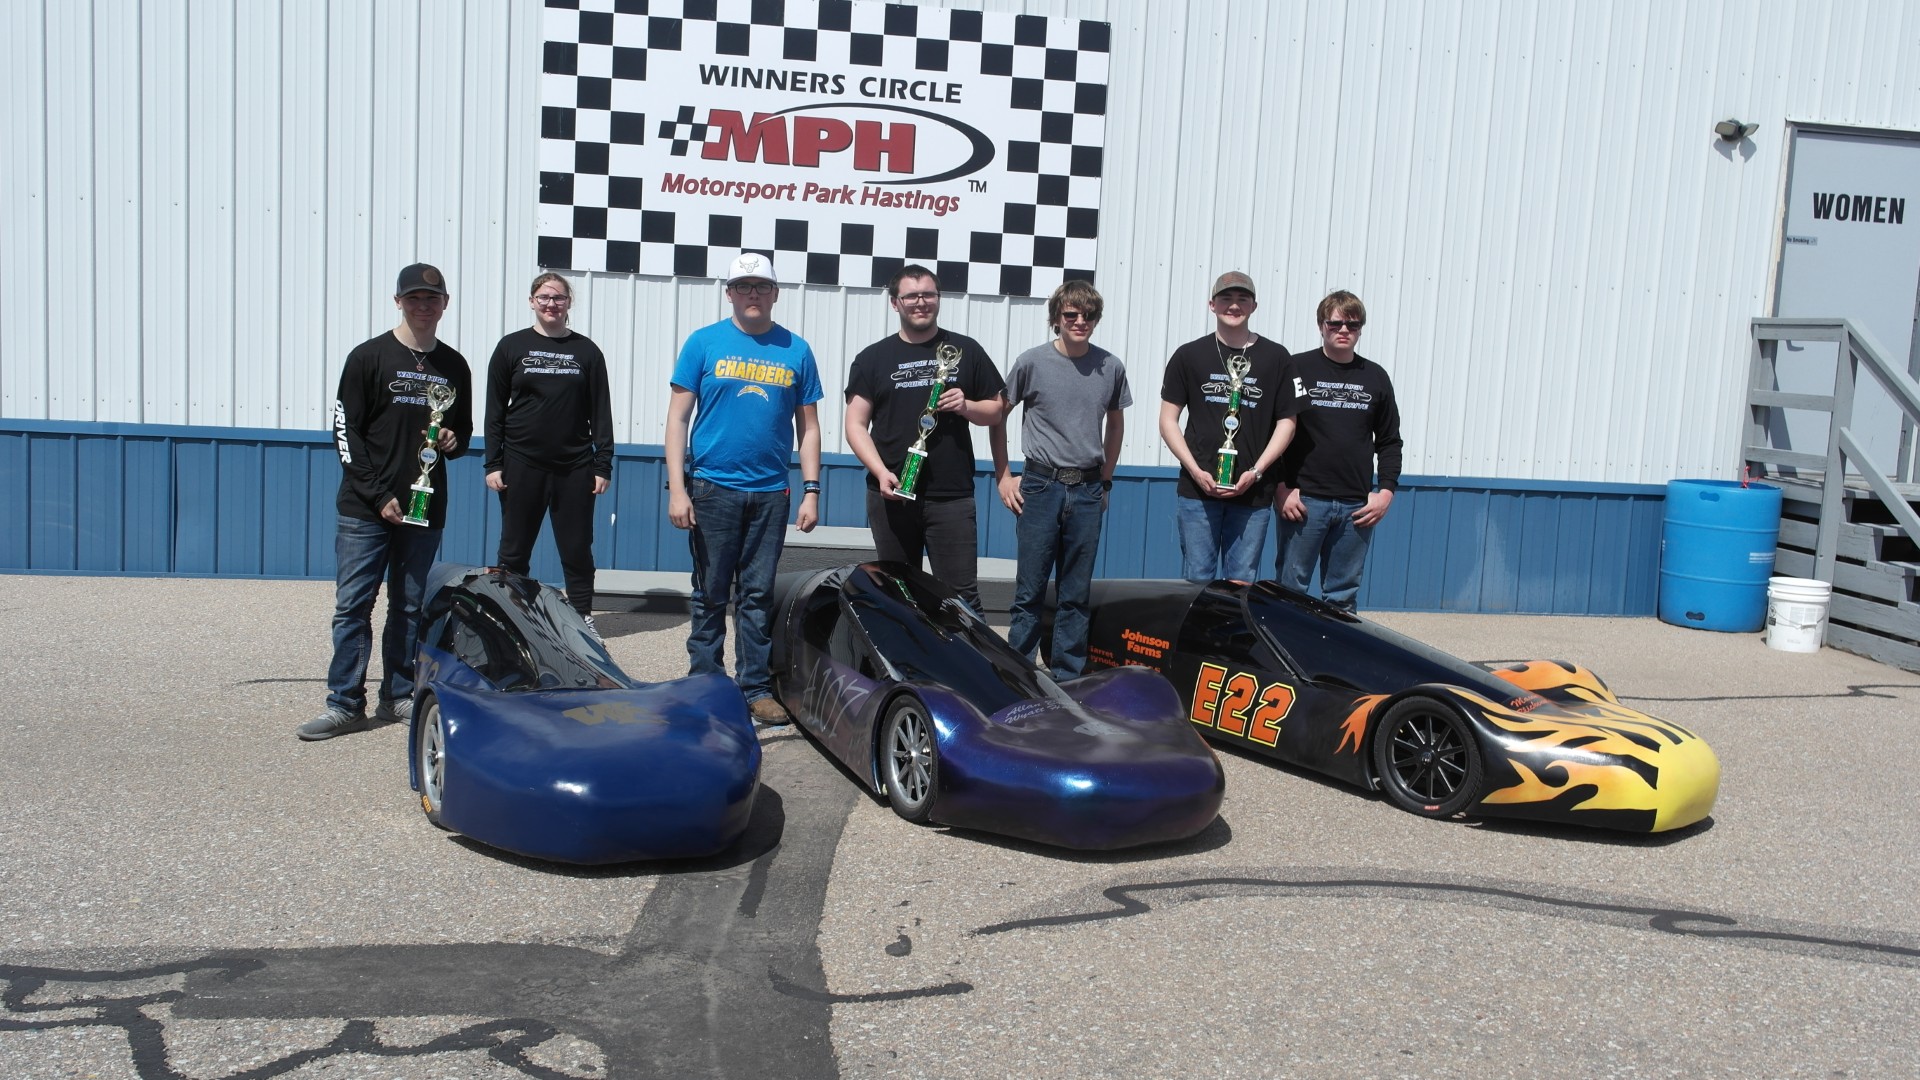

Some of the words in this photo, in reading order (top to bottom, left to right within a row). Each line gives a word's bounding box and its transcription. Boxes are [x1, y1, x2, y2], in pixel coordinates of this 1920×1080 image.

[699, 63, 846, 95] WINNERS
[859, 76, 963, 104] CIRCLE
[700, 108, 917, 174] MPH
[661, 172, 797, 204] Motorsport
[802, 182, 857, 205] Park
[860, 186, 961, 217] Hastings
[1813, 192, 1905, 225] WOMEN
[396, 370, 427, 380] WAYNE
[427, 375, 448, 385] HIGH
[715, 359, 795, 387] CHARGERS
[748, 357, 786, 368] ANGELES
[392, 395, 426, 406] POWER
[335, 399, 352, 464] DRIVER
[1121, 628, 1170, 650] Johnson
[1127, 640, 1162, 659] Farms
[800, 657, 870, 738] A107
[1190, 661, 1296, 748] E22
